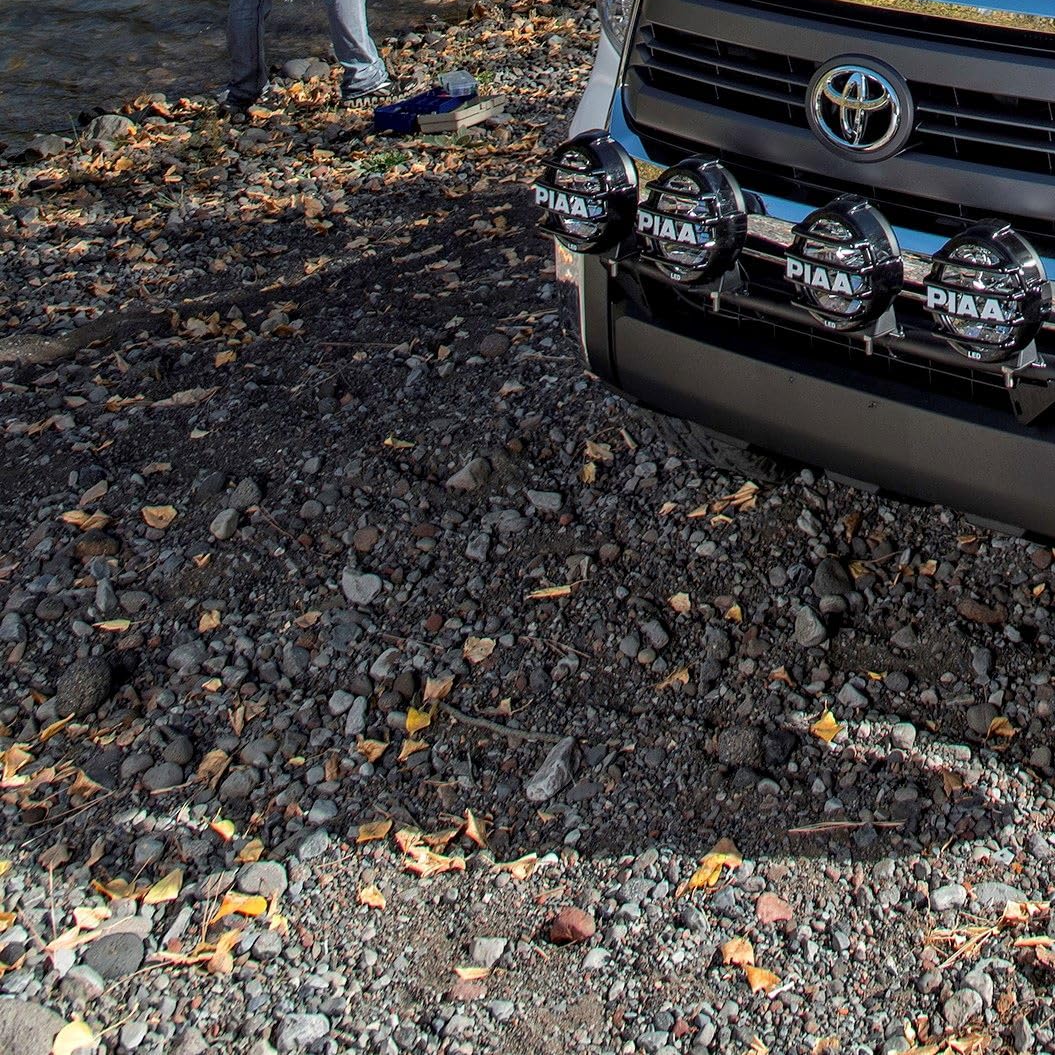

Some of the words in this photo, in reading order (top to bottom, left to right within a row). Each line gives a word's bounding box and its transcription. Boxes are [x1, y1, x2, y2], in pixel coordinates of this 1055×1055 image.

[535, 184, 589, 219] PIAA
[638, 210, 697, 245] PIAA
[670, 273, 682, 281] LED
[787, 257, 853, 296] PIAA
[927, 286, 1005, 322] PIAA
[824, 320, 837, 329] LED
[968, 351, 982, 360] LED
